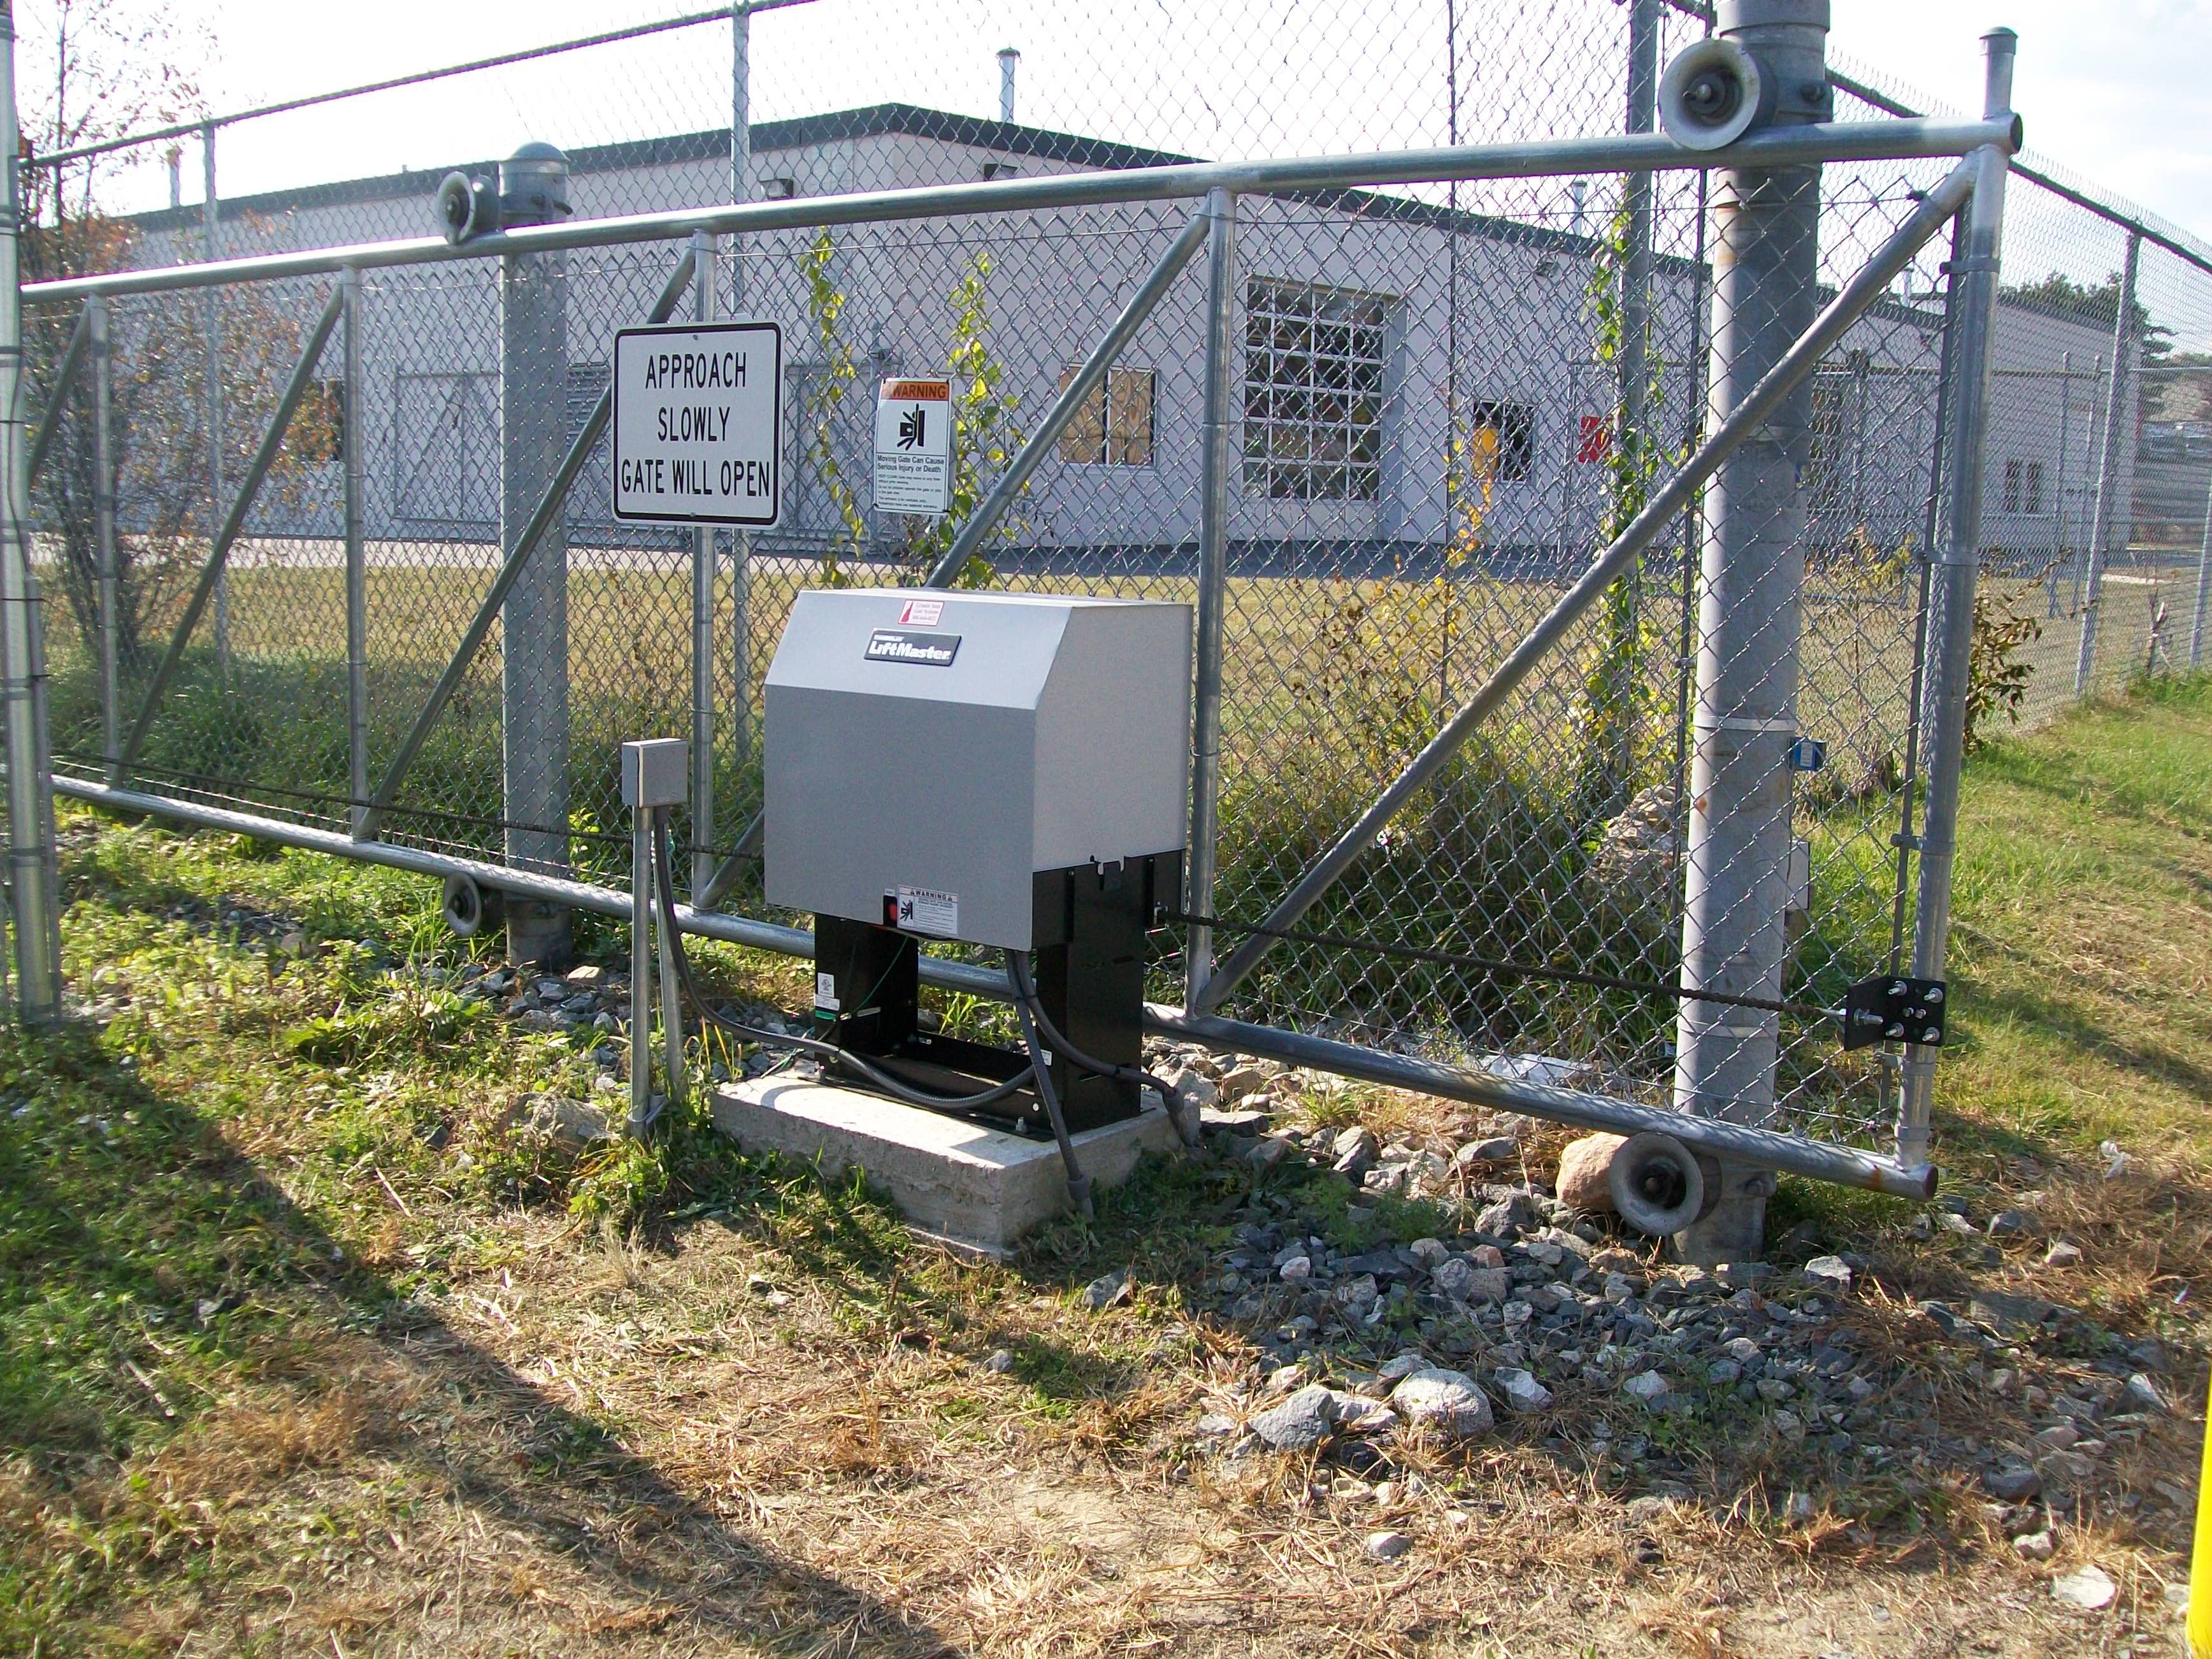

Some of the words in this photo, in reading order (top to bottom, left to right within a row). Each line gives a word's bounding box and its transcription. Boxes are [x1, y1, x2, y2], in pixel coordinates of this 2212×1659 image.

[645, 352, 747, 389] APPROACH
[893, 384, 946, 398] WARNING
[657, 406, 731, 442] SLOWLY
[877, 455, 897, 463] Moving
[898, 464, 914, 473] Injury
[621, 459, 664, 494] GATE
[672, 459, 713, 495] WILL
[721, 460, 770, 497] OPEN
[916, 890, 947, 900] WARNING
